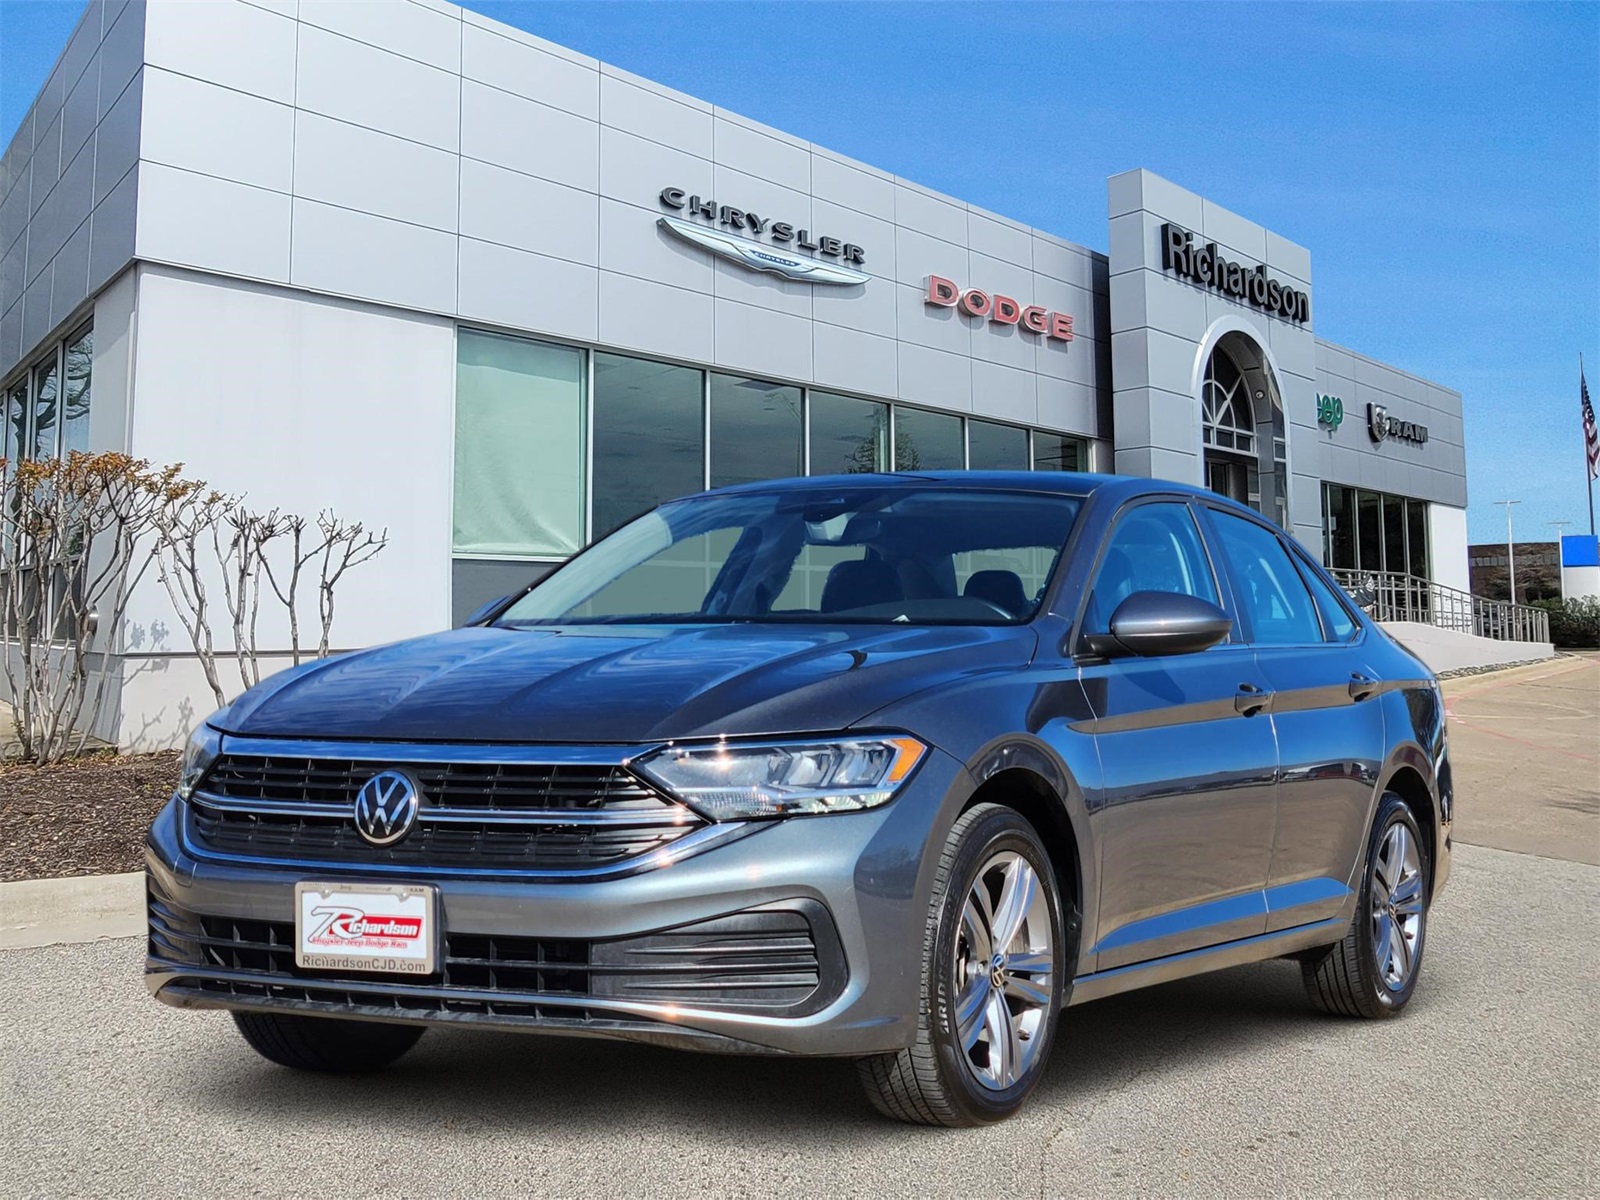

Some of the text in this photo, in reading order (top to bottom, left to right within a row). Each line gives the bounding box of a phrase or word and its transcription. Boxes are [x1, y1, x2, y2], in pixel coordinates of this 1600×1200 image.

[659, 186, 866, 265] CHRYSLER
[1161, 223, 1310, 323] Richardson
[924, 274, 1074, 342] DODGE
[1387, 416, 1429, 443] RAM
[308, 905, 418, 943] Richardson
[302, 955, 426, 972] RichardsonCJD.com
